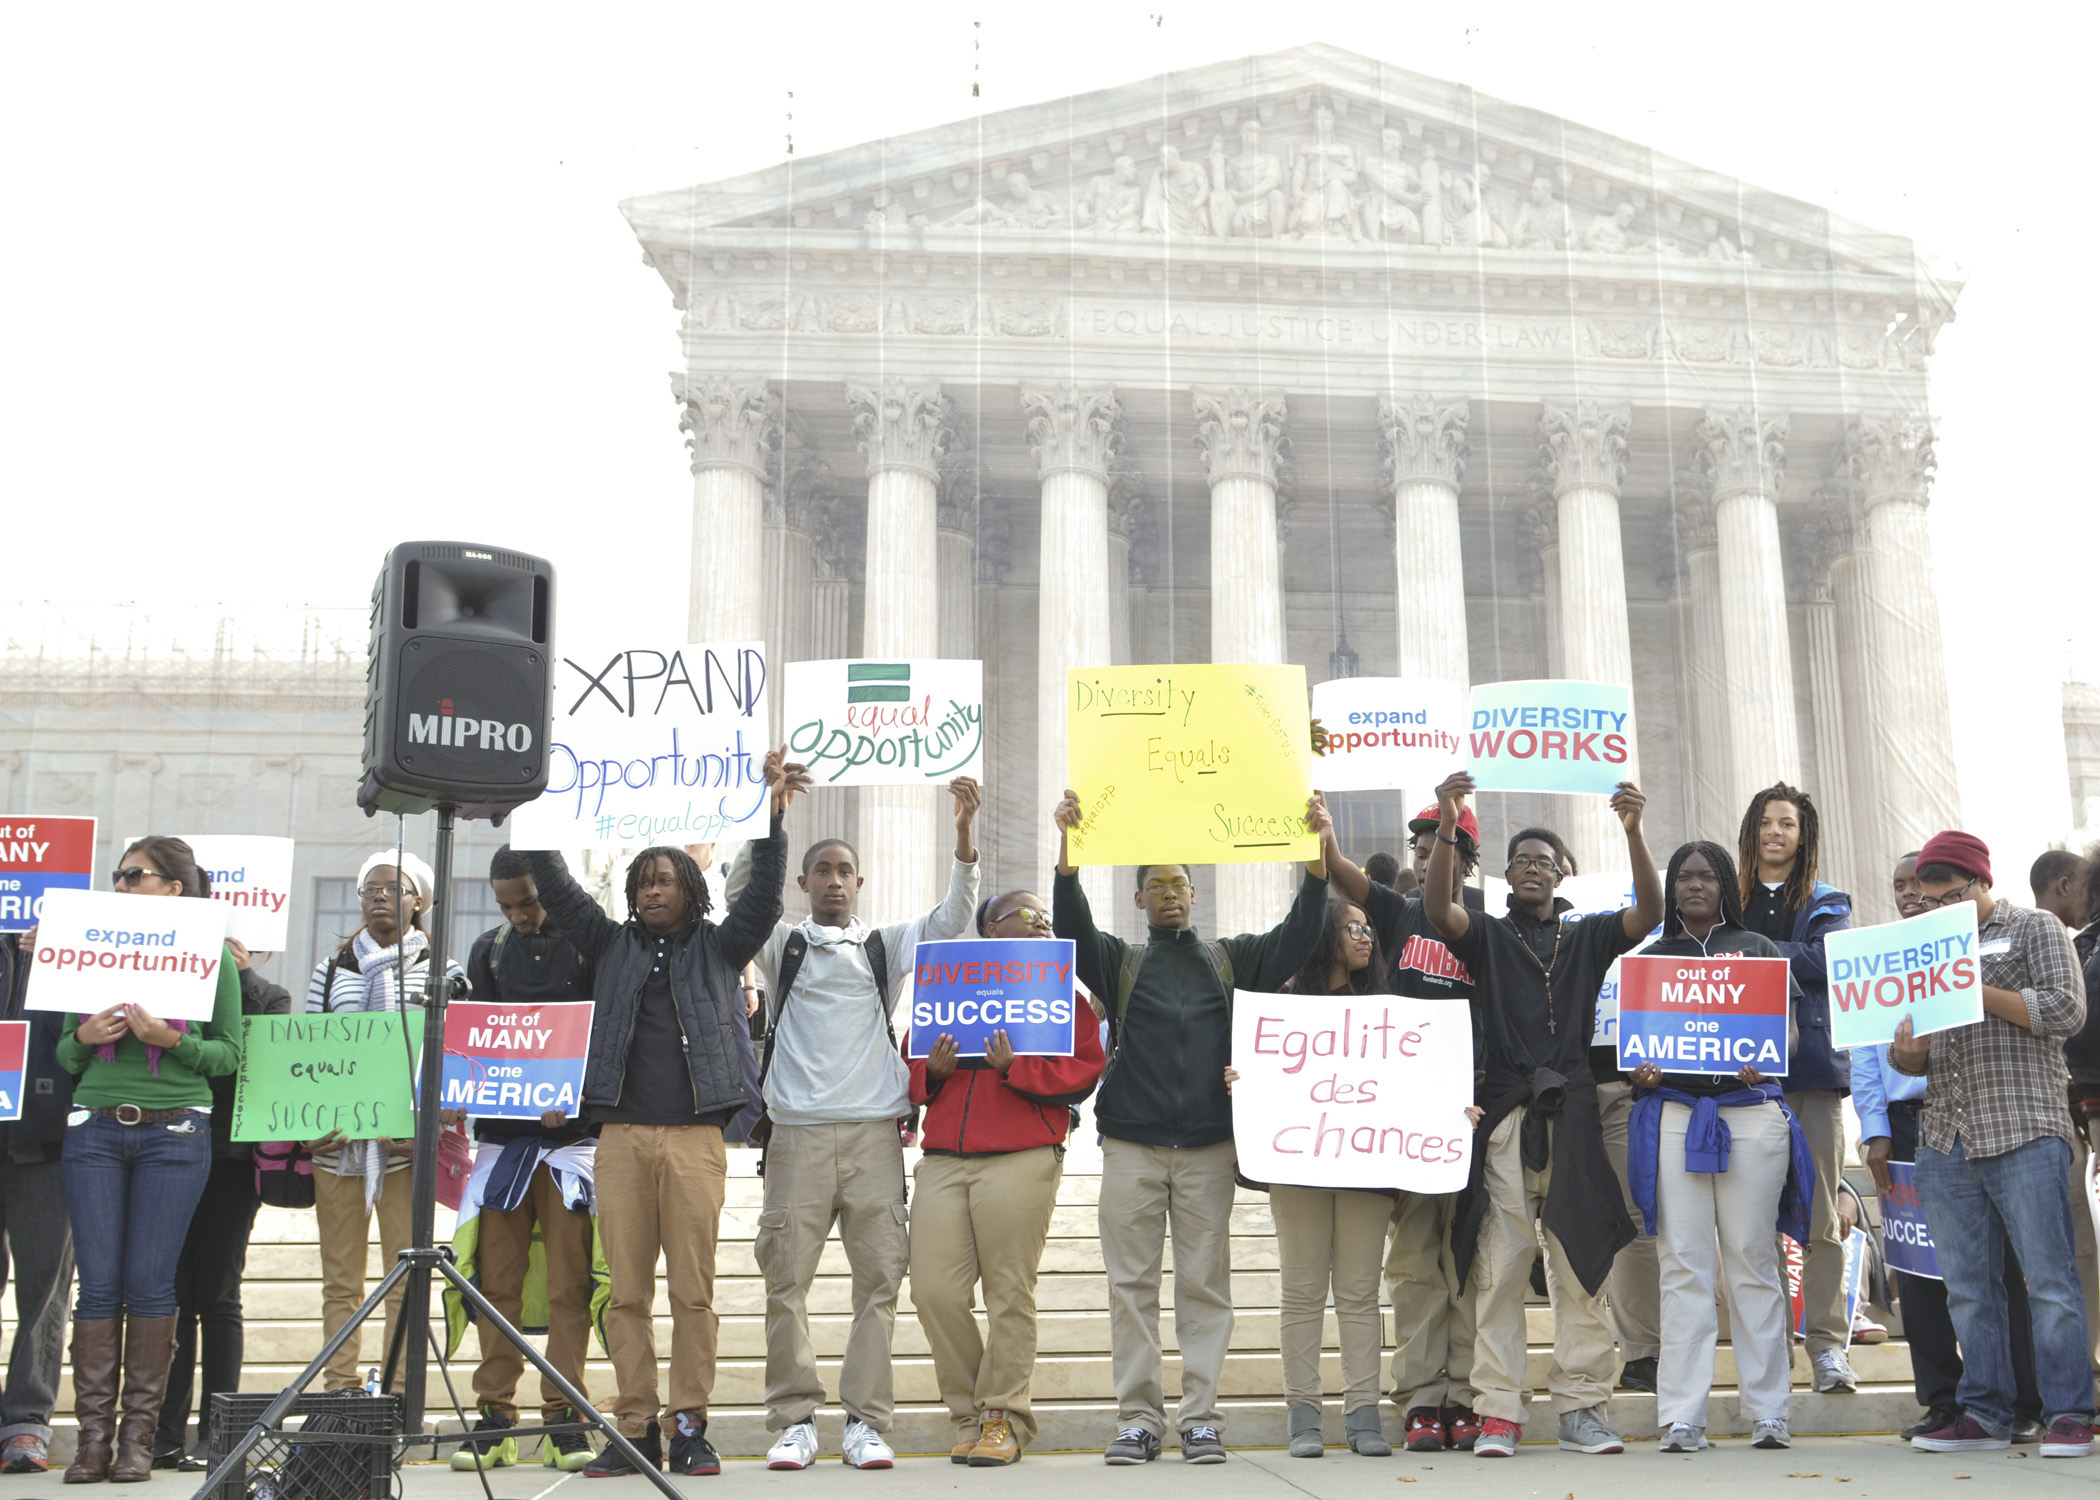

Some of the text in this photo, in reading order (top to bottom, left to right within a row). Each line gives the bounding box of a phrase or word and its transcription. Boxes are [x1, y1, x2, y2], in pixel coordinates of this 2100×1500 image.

[1093, 309, 1562, 349] EQUAL JUSTICE UNDER LAW
[844, 694, 931, 738] equal
[1076, 678, 1196, 727] Diversity
[1348, 708, 1427, 728] expand
[1472, 707, 1628, 732] DIVERSITY
[1148, 736, 1230, 784] Equals
[1469, 729, 1628, 764] WORKS
[544, 727, 768, 823] Opportunity
[16, 824, 36, 839] of
[1209, 803, 1305, 843] Success
[85, 928, 176, 948] expand
[37, 947, 217, 980] opportunity
[1399, 934, 1476, 987] DUNBA
[1832, 932, 1973, 981] DIVERSITY
[917, 961, 1072, 986] DIVERSITY
[1676, 967, 1731, 980] out of
[1832, 958, 1976, 1012] WORKS
[976, 988, 1004, 996] equals
[1661, 982, 1746, 1005] MANY
[487, 1013, 541, 1026] out of
[914, 999, 1071, 1027] SUCCESS
[1684, 1021, 1719, 1032] one
[270, 1017, 397, 1045] DIVERSITY
[467, 1027, 553, 1050] MANY
[1254, 1007, 1431, 1075] Egalité
[1623, 1034, 1781, 1063] AMERICA
[290, 1059, 358, 1083] equals
[488, 1066, 522, 1078] one
[441, 1079, 574, 1107] MERICA
[1309, 1073, 1378, 1104] des
[267, 1101, 386, 1133] SUCCESS
[1272, 1112, 1463, 1164] chances
[1879, 1214, 1936, 1249] SUCCE
